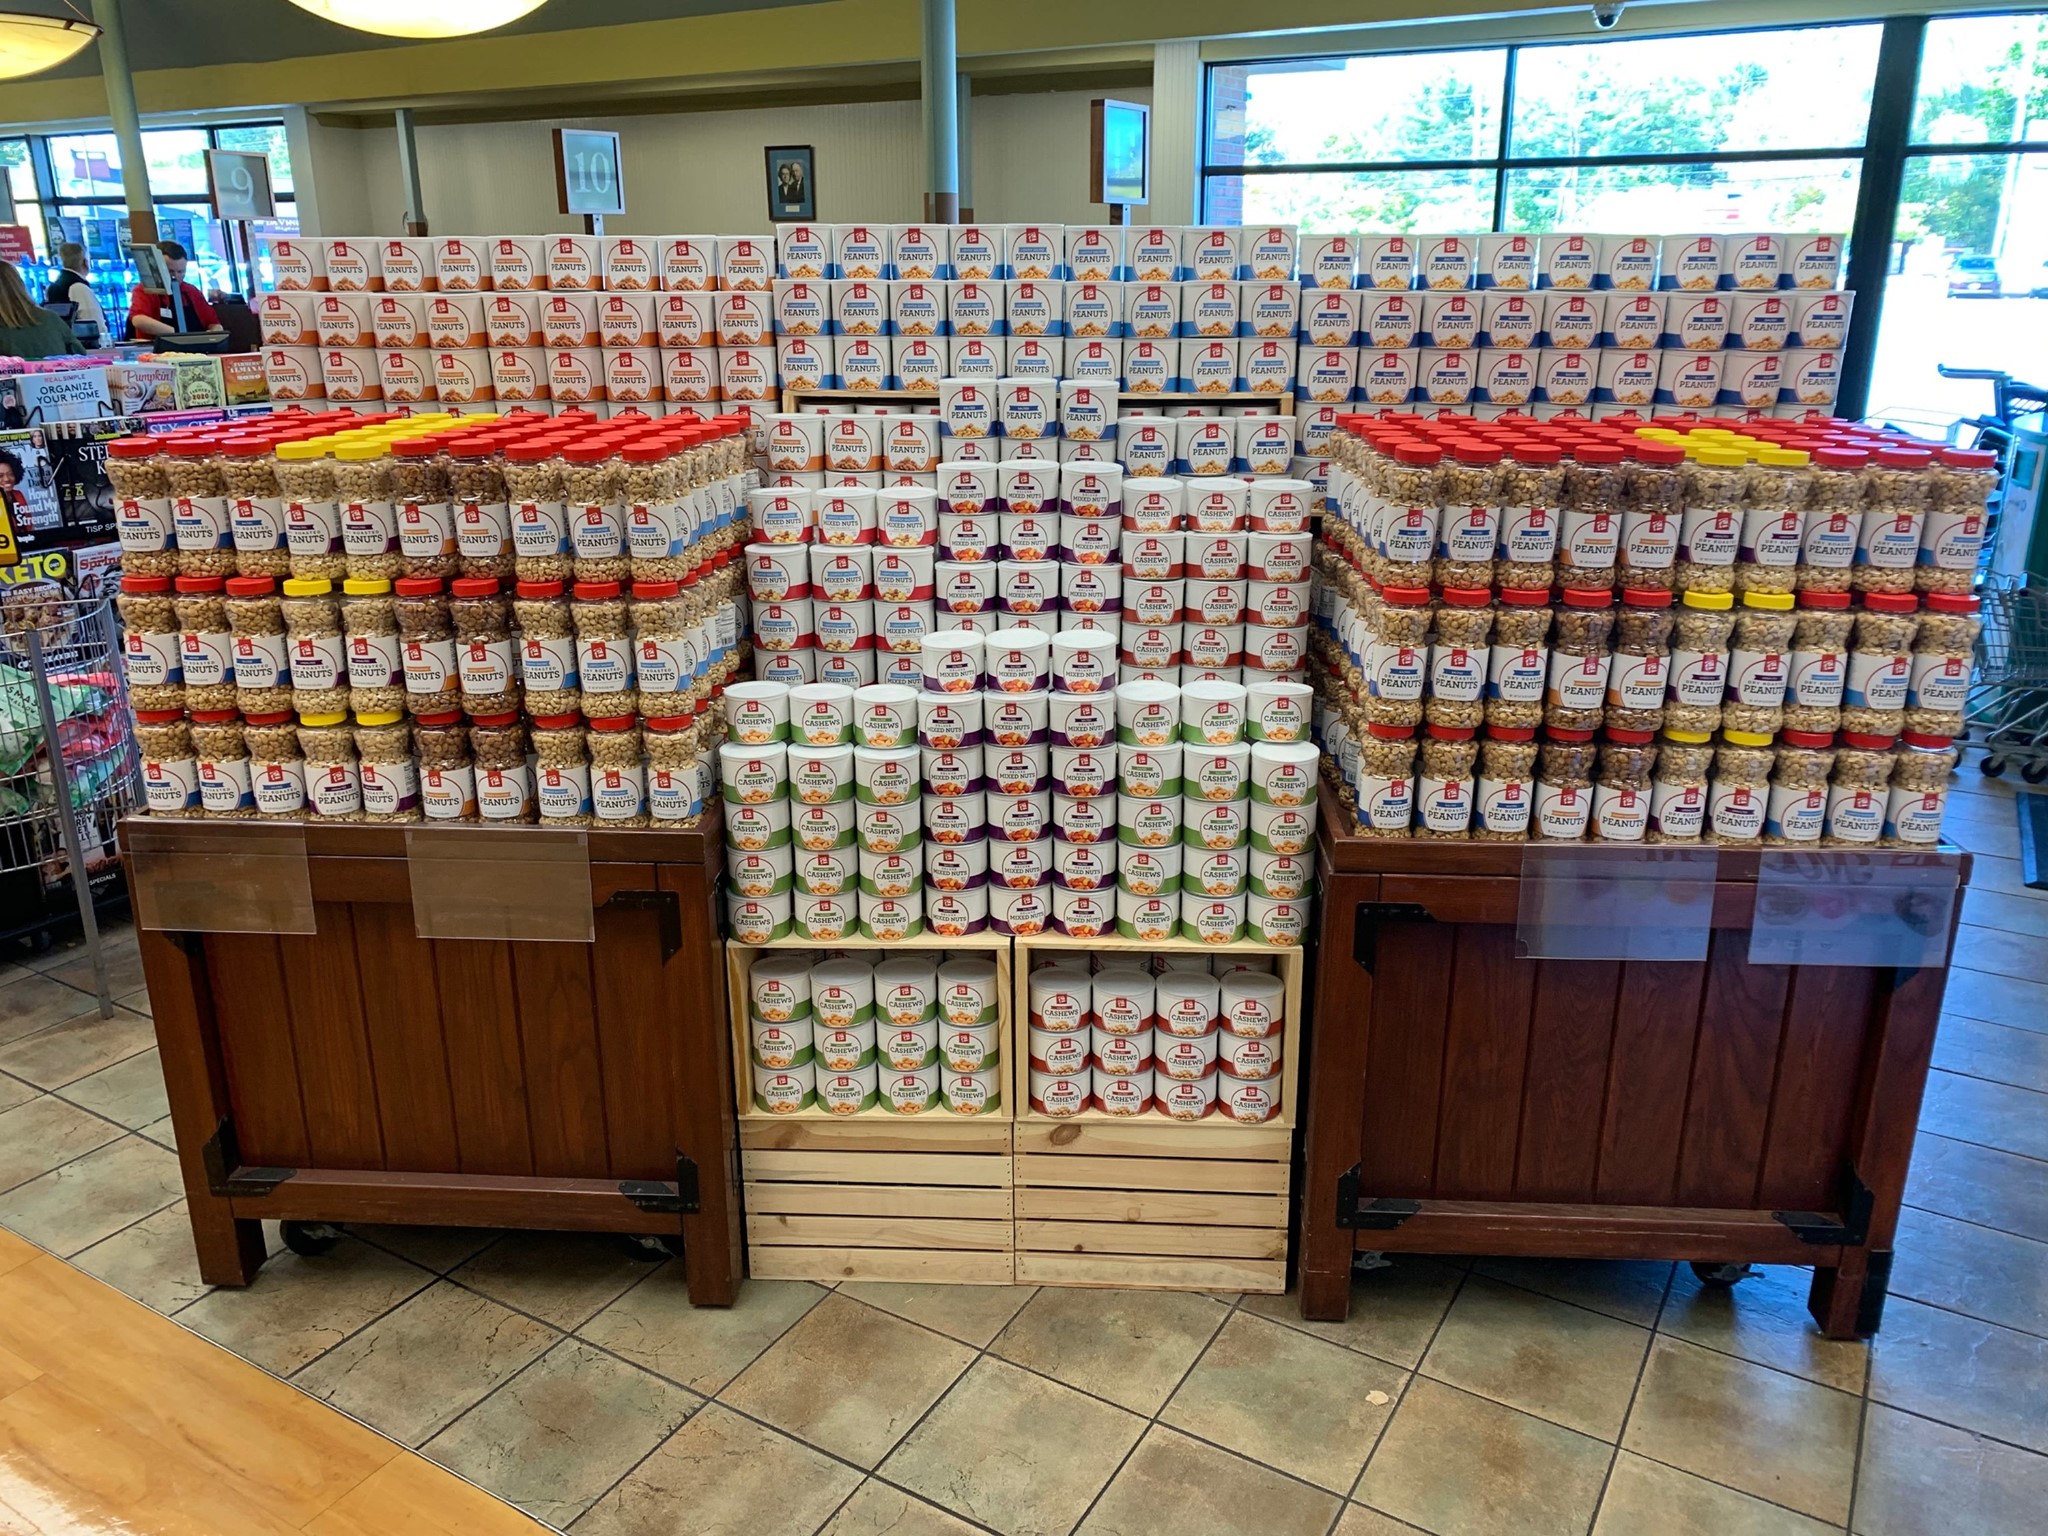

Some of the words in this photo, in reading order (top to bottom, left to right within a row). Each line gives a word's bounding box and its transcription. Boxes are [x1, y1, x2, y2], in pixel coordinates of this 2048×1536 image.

[574, 151, 611, 194] 10
[231, 166, 254, 205] 9
[787, 252, 822, 260] PEANUTS
[1075, 255, 1110, 263] PEANUTS
[784, 309, 819, 317] PEANUTS
[1012, 309, 1046, 317] PEANUTS
[603, 321, 637, 329] PEANUTS
[723, 320, 759, 328] PEANUTS
[1314, 319, 1350, 327] PEANUTS
[1437, 321, 1473, 329] PEANUTS
[959, 365, 993, 373] PEANUTS
[1077, 367, 1112, 375] PEANUTS
[1197, 367, 1231, 375] PEANUTS
[123, 369, 175, 383] Pumpkin!
[612, 376, 646, 384] PEANUTS
[40, 382, 94, 395] ORGANIZE
[36, 395, 68, 404] YOUR
[71, 390, 100, 401] HOME
[951, 411, 987, 419] PEANUTS
[1066, 413, 1102, 422] PEANUTS
[78, 445, 108, 461] STE
[771, 445, 805, 454] PEANUTS
[890, 446, 925, 454] PEANUTS
[1252, 447, 1288, 455] PEANUTS
[1129, 450, 1165, 459] PEANUTS
[28, 487, 48, 500] How
[13, 501, 42, 514] Found
[43, 500, 58, 512] My
[1137, 510, 1170, 518] CASHEWS
[1268, 510, 1302, 518] CASHEWS
[17, 513, 59, 526] Strength
[516, 535, 556, 545] PEANUTS
[577, 536, 619, 546] PEANUTS
[1390, 540, 1431, 550] PEANUTS
[1452, 540, 1493, 549] PEANUTS
[1139, 603, 1172, 611] CASHEWS
[1193, 645, 1226, 654] CASHEWS
[463, 671, 504, 681] PEANUTS
[583, 670, 624, 681] PEANUTS
[1381, 678, 1423, 688] PEANUTS
[737, 718, 772, 726] CASHEWS
[1136, 720, 1170, 728] CASHEWS
[1264, 716, 1299, 724] CASHEWS
[1126, 771, 1160, 779] CASHEWS
[738, 778, 774, 786] CASHEWS
[258, 791, 300, 803] PEANUTS
[318, 793, 359, 804] PEANUTS
[480, 796, 520, 806] PEANUTS
[597, 798, 636, 808] PEANUTS
[1428, 811, 1469, 820] PEANUTS
[1543, 815, 1585, 825] PEANUTS
[1716, 816, 1759, 827] PEANUTS
[1203, 824, 1238, 832] CASHEWS
[1835, 819, 1879, 830] PEANUTS
[89, 873, 116, 886] SPECIALS
[1136, 916, 1170, 924] CASHEWS
[1045, 1009, 1078, 1017] CASHEWS
[1233, 1016, 1267, 1024] CASHEWS
[825, 1046, 858, 1054] CASHEWS
[1170, 1098, 1204, 1106] CASHEWS
